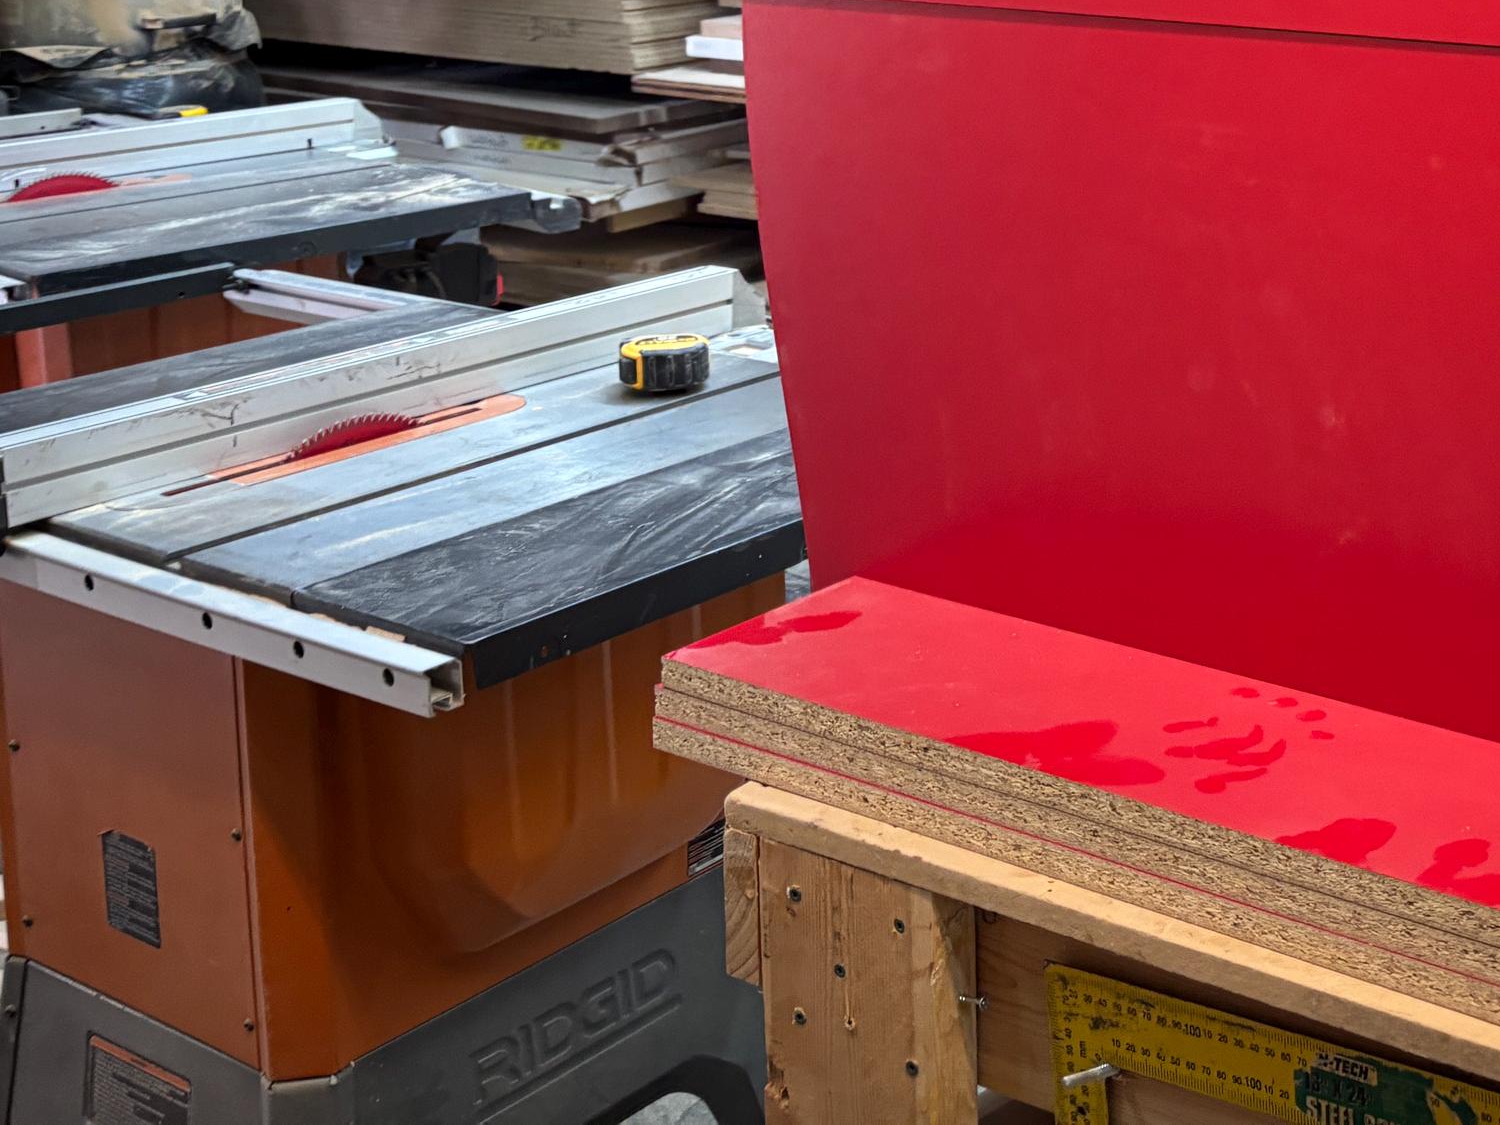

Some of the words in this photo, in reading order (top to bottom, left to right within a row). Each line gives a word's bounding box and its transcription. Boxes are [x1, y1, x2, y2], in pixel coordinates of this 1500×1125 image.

[469, 948, 678, 1106] RIDGID
[1142, 1011, 1151, 1021] 70
[1185, 1023, 1201, 1038] 100
[1203, 1029, 1212, 1040] 10
[1218, 1033, 1228, 1044] 20
[1264, 1047, 1275, 1058] 50
[1296, 1056, 1307, 1068] 70
[1111, 1038, 1121, 1049] 10
[1125, 1042, 1136, 1053] 20
[1140, 1047, 1151, 1057] 30
[1169, 1056, 1181, 1067] 50
[1186, 1060, 1196, 1071] 60
[1201, 1065, 1211, 1076] 70
[1232, 1074, 1242, 1085] 90
[1245, 1076, 1262, 1092] 100
[1264, 1084, 1274, 1095] 10
[1279, 1089, 1290, 1100] 20
